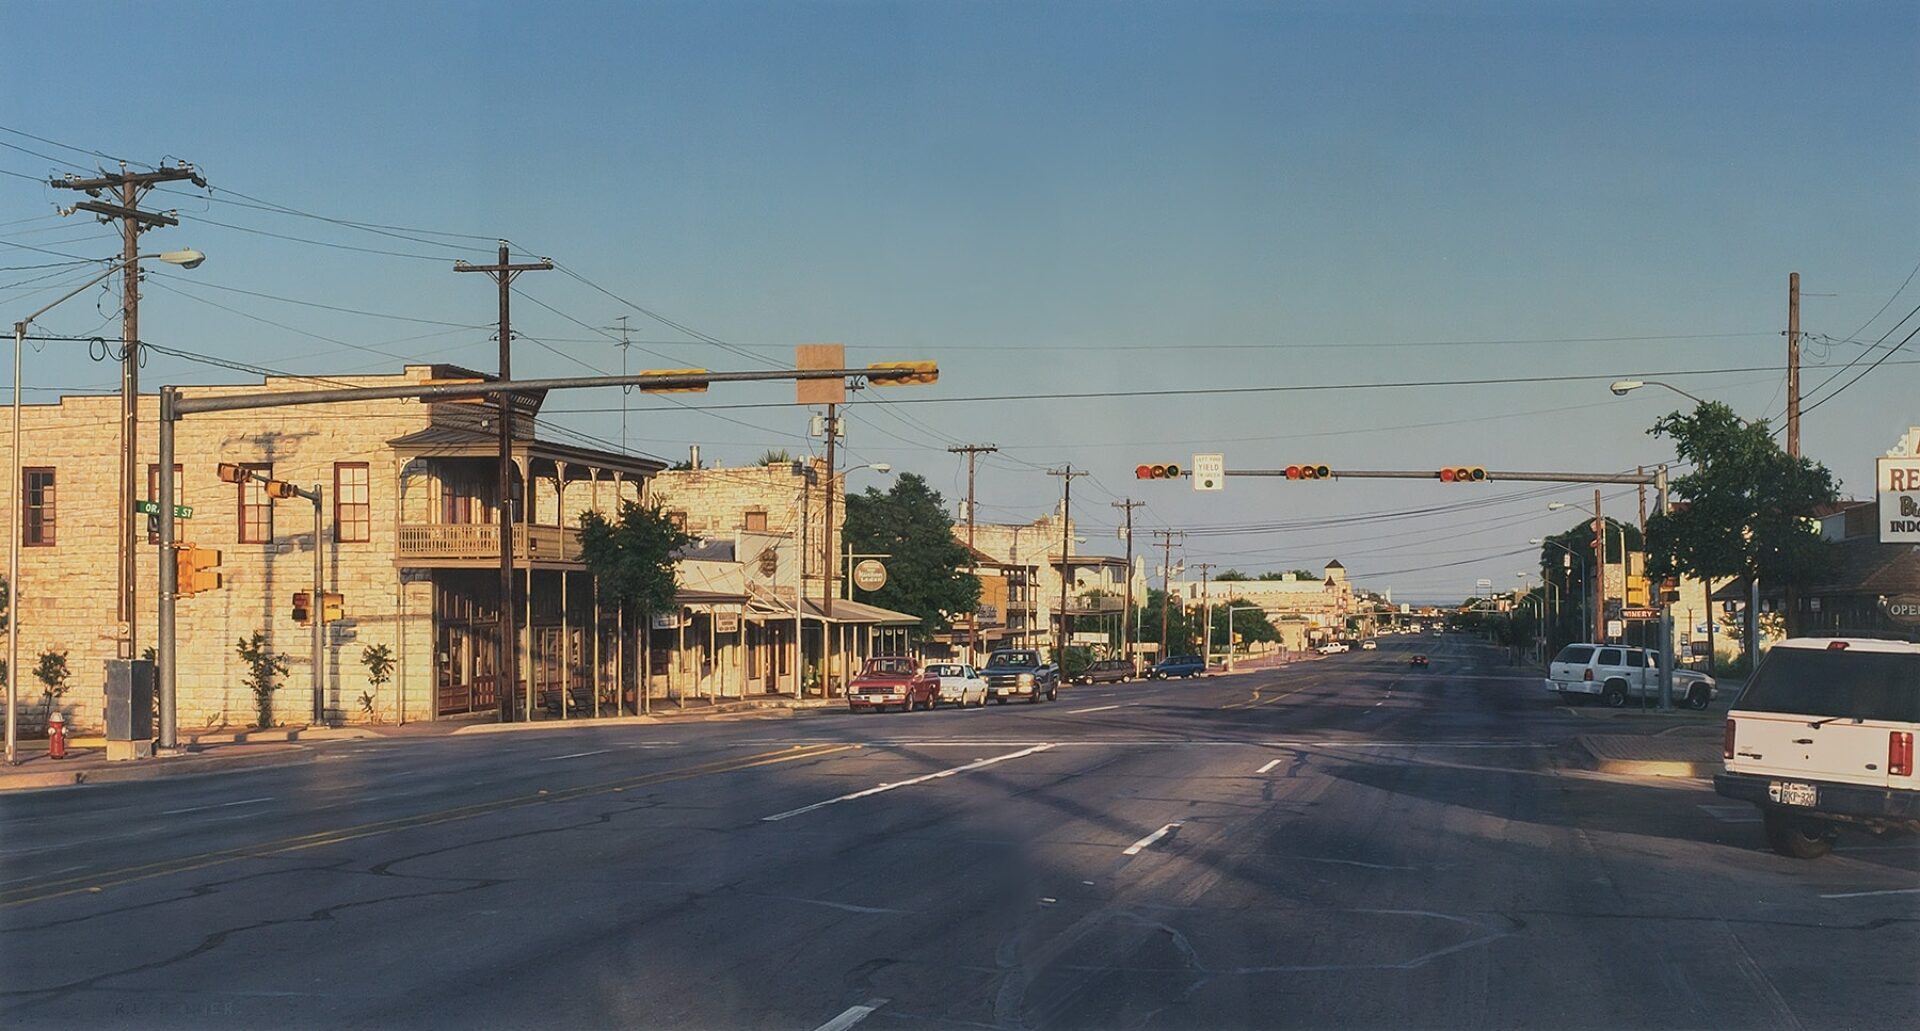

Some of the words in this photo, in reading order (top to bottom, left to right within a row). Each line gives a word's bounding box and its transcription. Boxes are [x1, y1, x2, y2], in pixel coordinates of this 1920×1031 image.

[145, 503, 179, 516] ORE
[181, 508, 192, 518] ST
[1890, 604, 1920, 615] OPE
